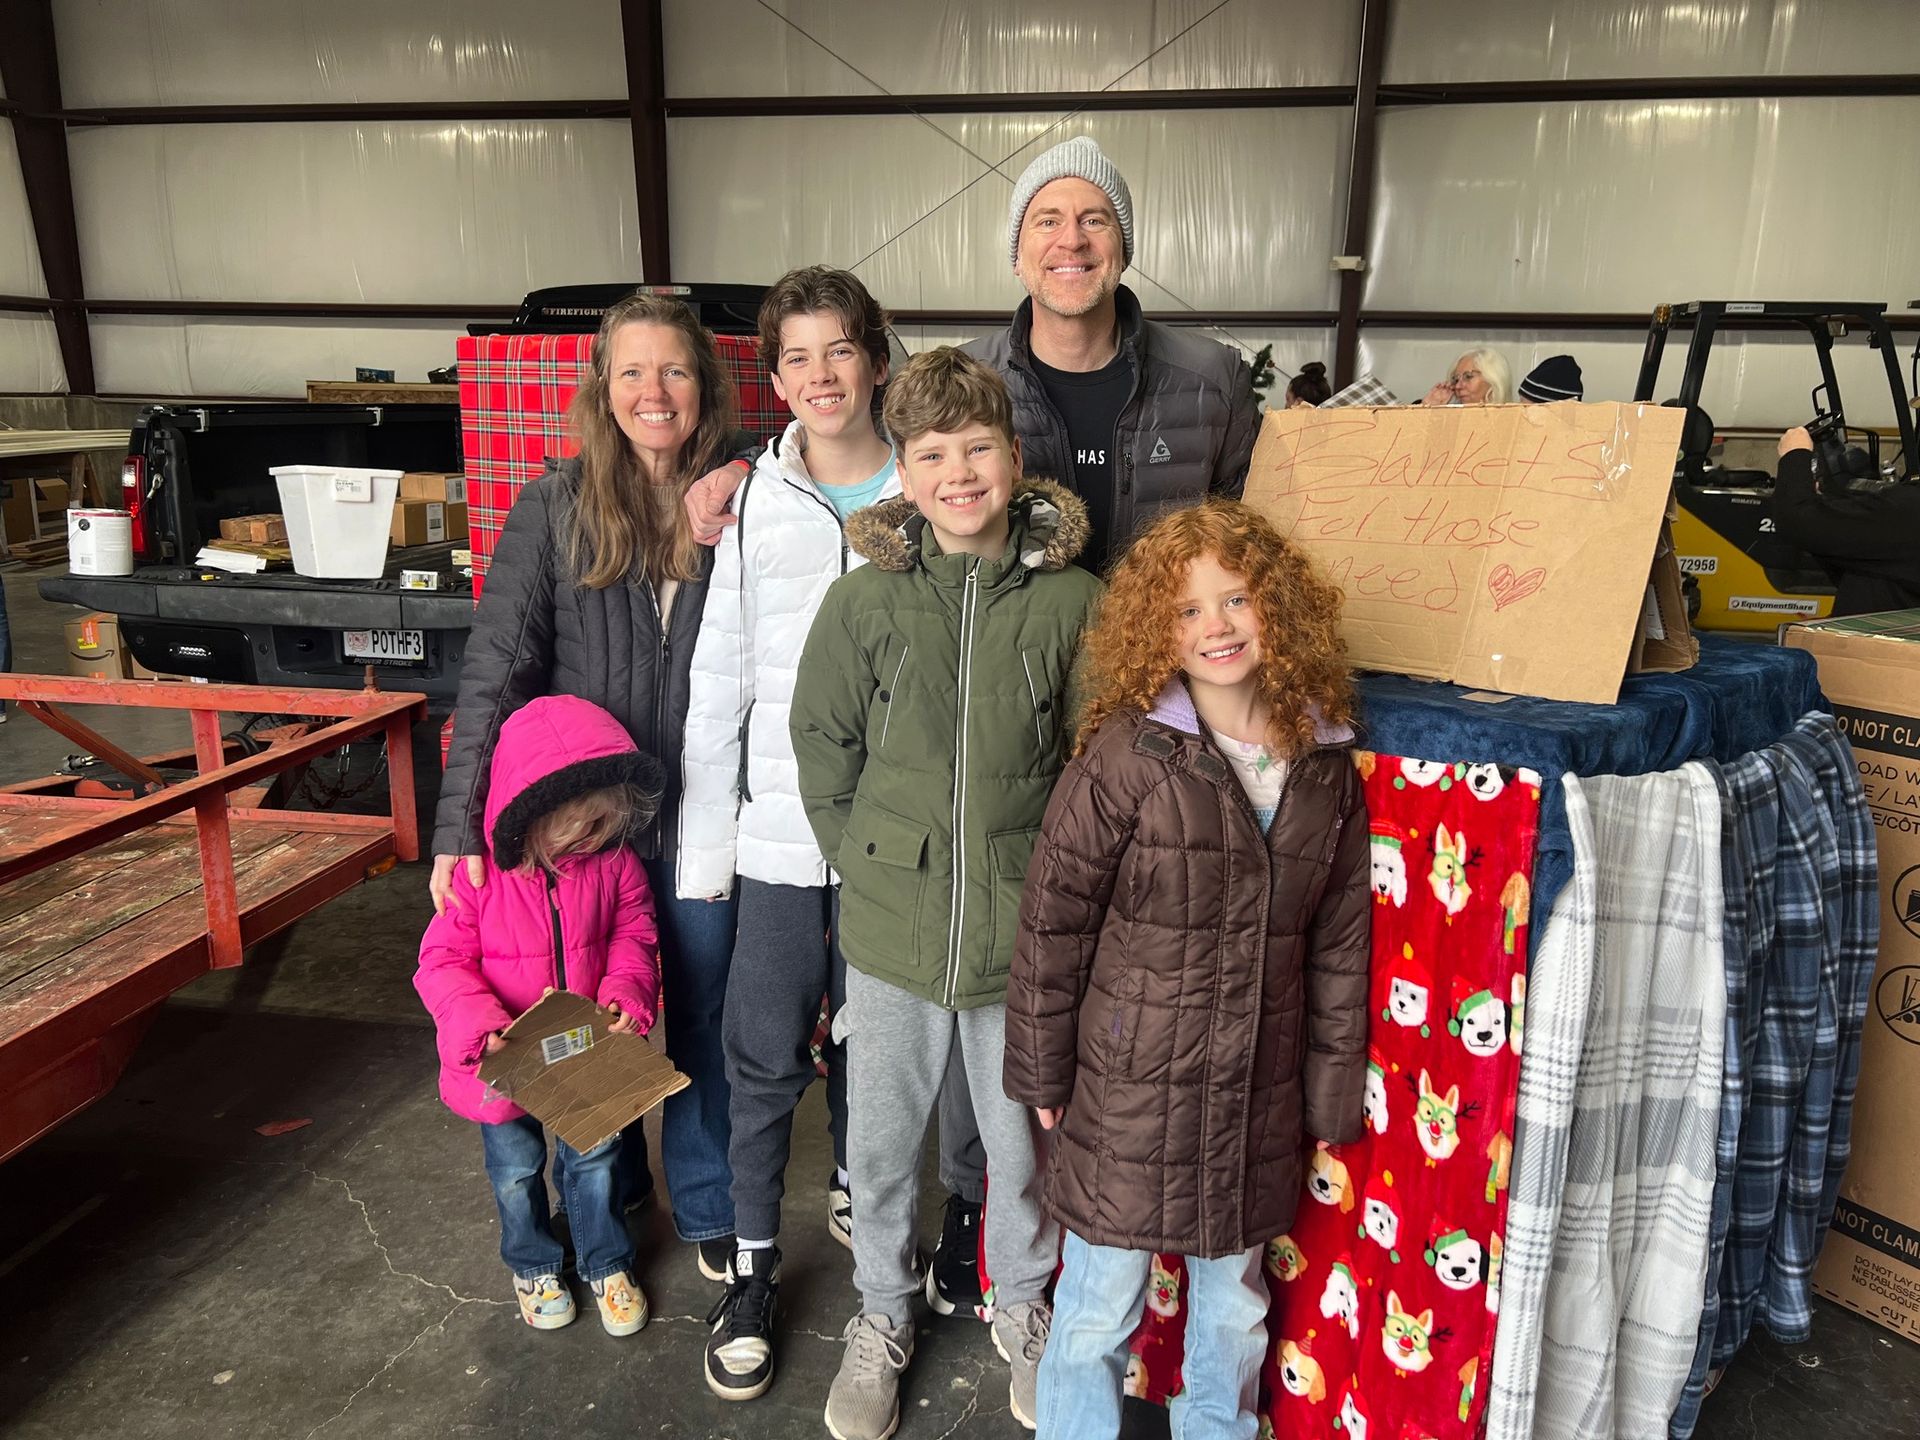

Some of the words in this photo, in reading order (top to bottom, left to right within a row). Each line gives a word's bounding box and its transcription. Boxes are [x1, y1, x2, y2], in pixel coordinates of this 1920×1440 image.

[550, 307, 608, 316] FIREFIGHT
[1077, 449, 1106, 465] HAS
[1403, 497, 1540, 550] those
[1741, 600, 1814, 611] EquipmentShare
[1853, 718, 1889, 741] NOT
[1858, 761, 1898, 780] OAD
[1835, 1206, 1869, 1233] NOT
[1872, 1224, 1920, 1258] CLAM
[1855, 1255, 1870, 1267] DO
[1872, 1263, 1893, 1278] NOT
[1894, 1273, 1913, 1287] LAY
[1851, 1274, 1867, 1287] NO
[1869, 1283, 1920, 1312] COLOQUE
[1880, 1306, 1908, 1324] CUT
